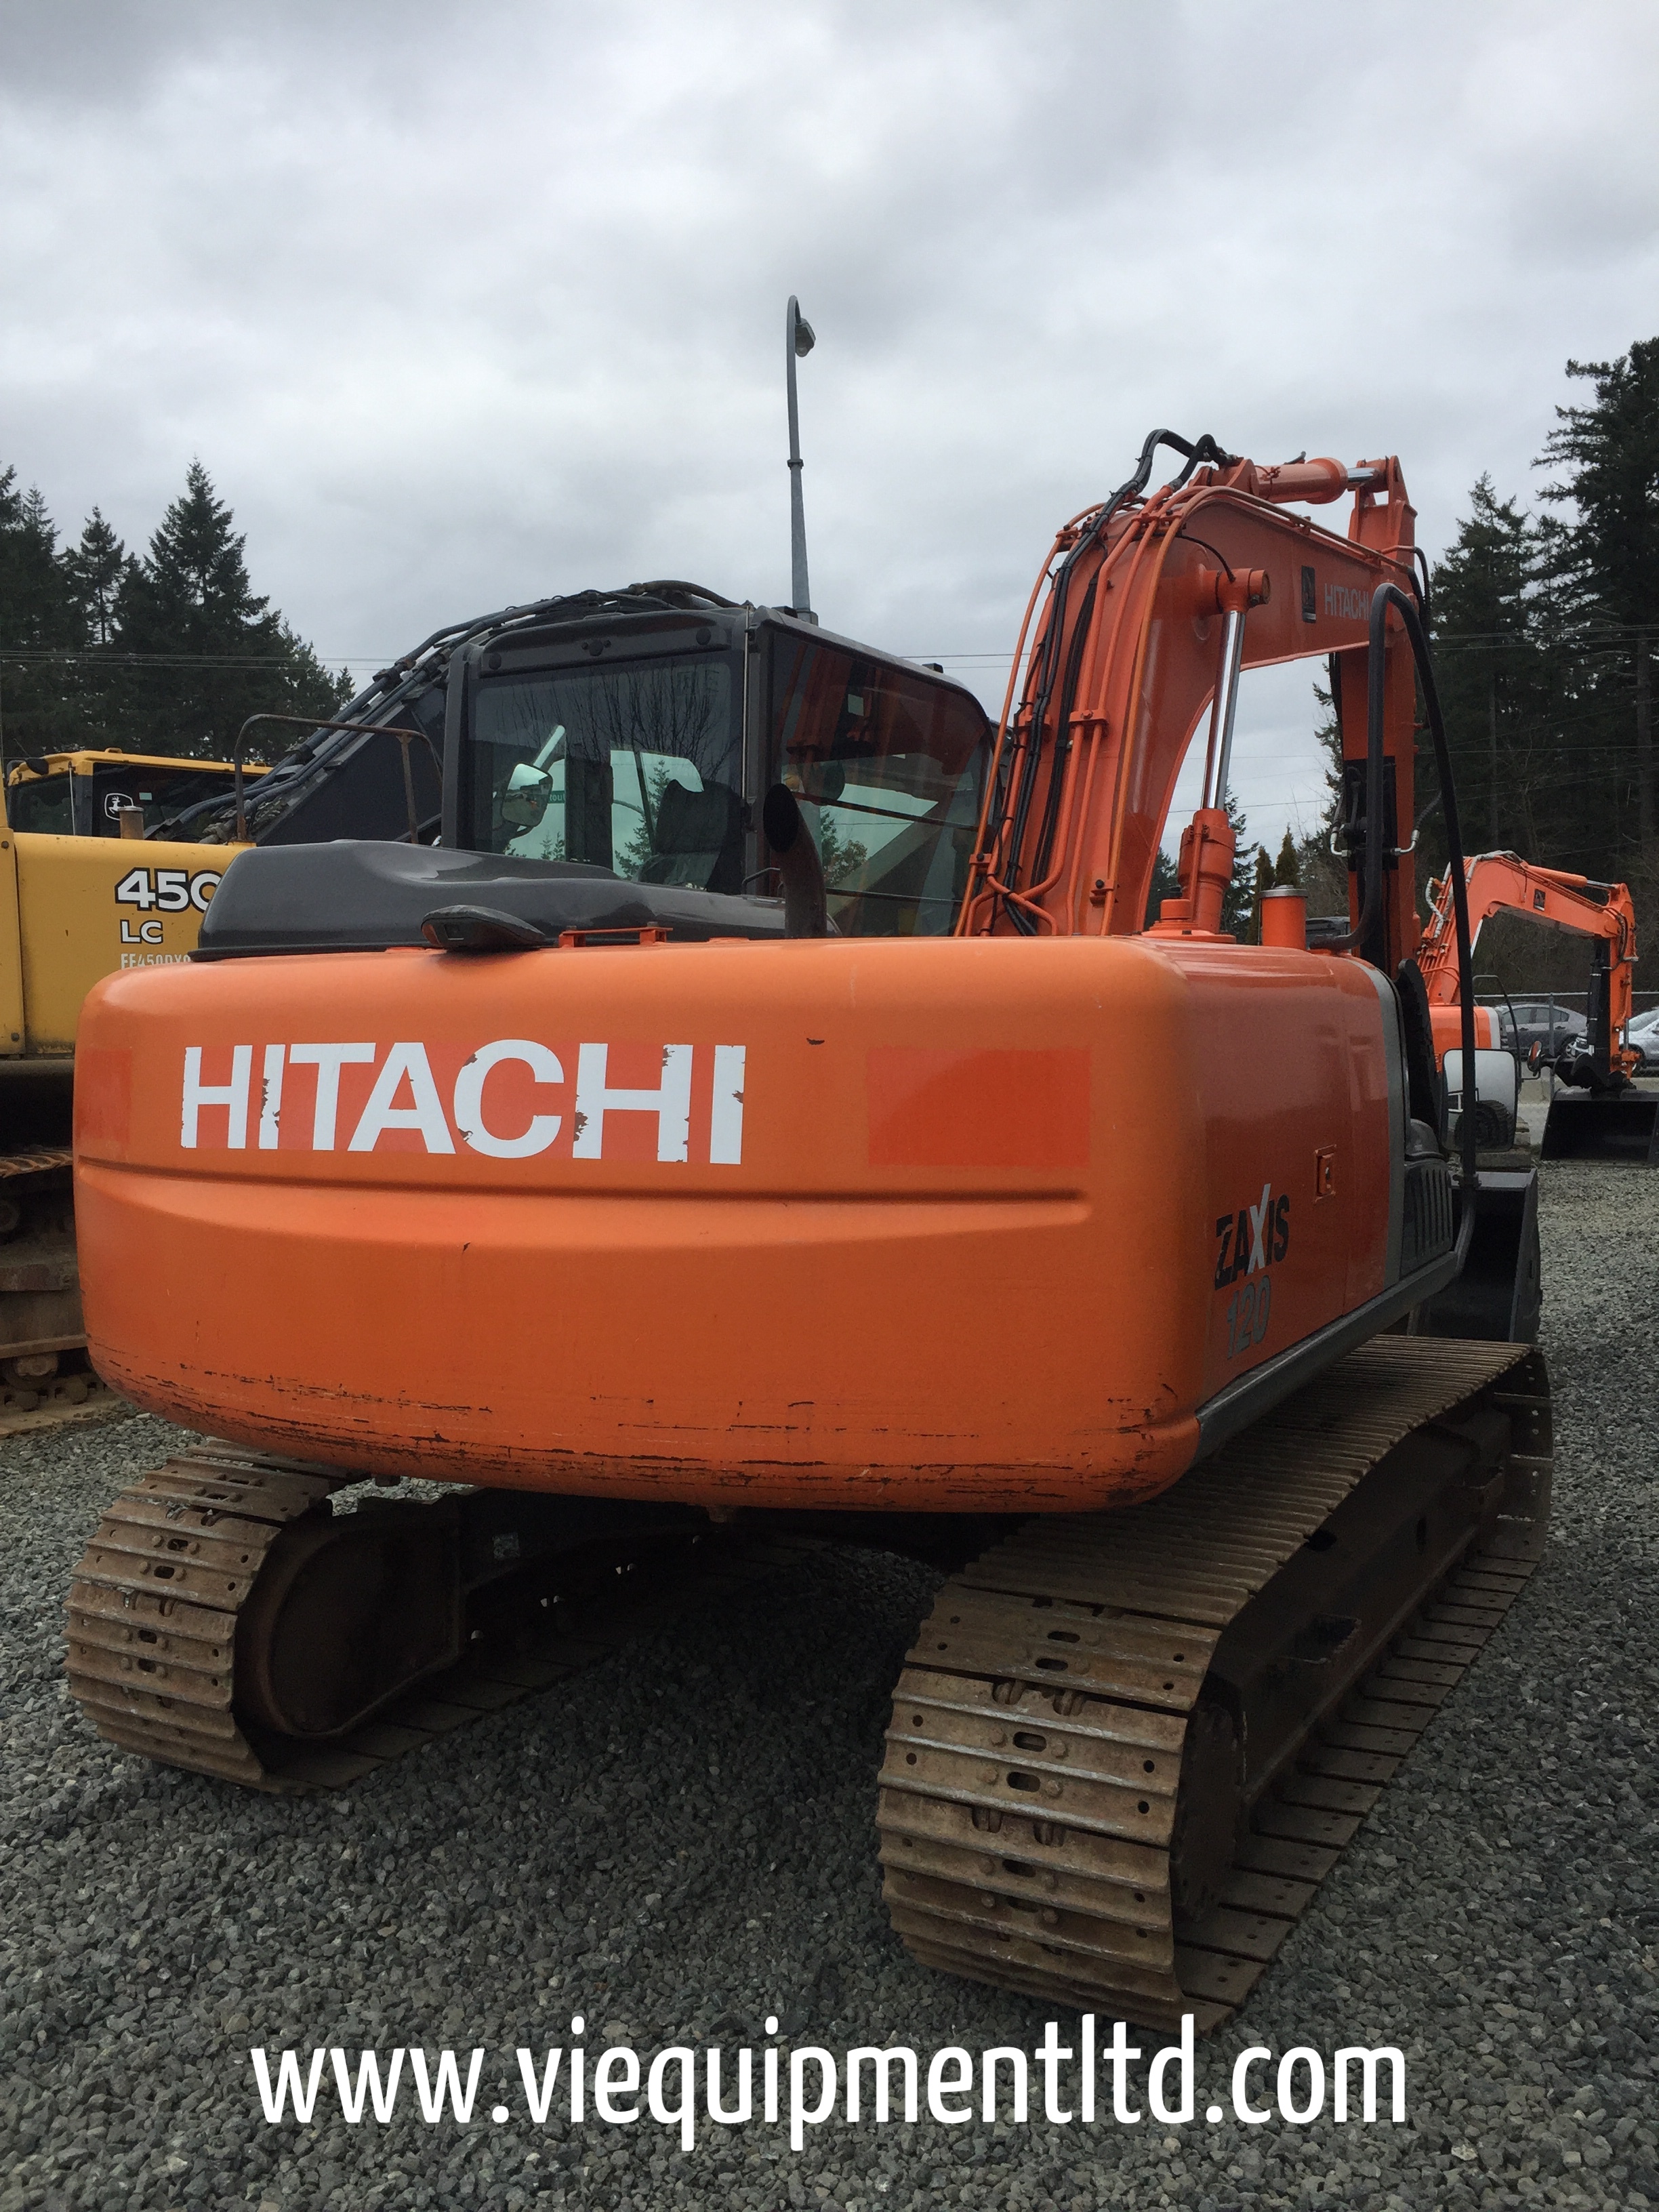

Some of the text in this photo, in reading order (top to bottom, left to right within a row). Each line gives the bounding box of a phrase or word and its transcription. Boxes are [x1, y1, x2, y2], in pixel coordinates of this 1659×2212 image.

[1324, 583, 1369, 621] HITACHI
[120, 919, 163, 945] LC
[180, 1039, 746, 1164] HITACHI
[1214, 1183, 1290, 1290] ZAXIS
[1227, 1275, 1271, 1360] 120
